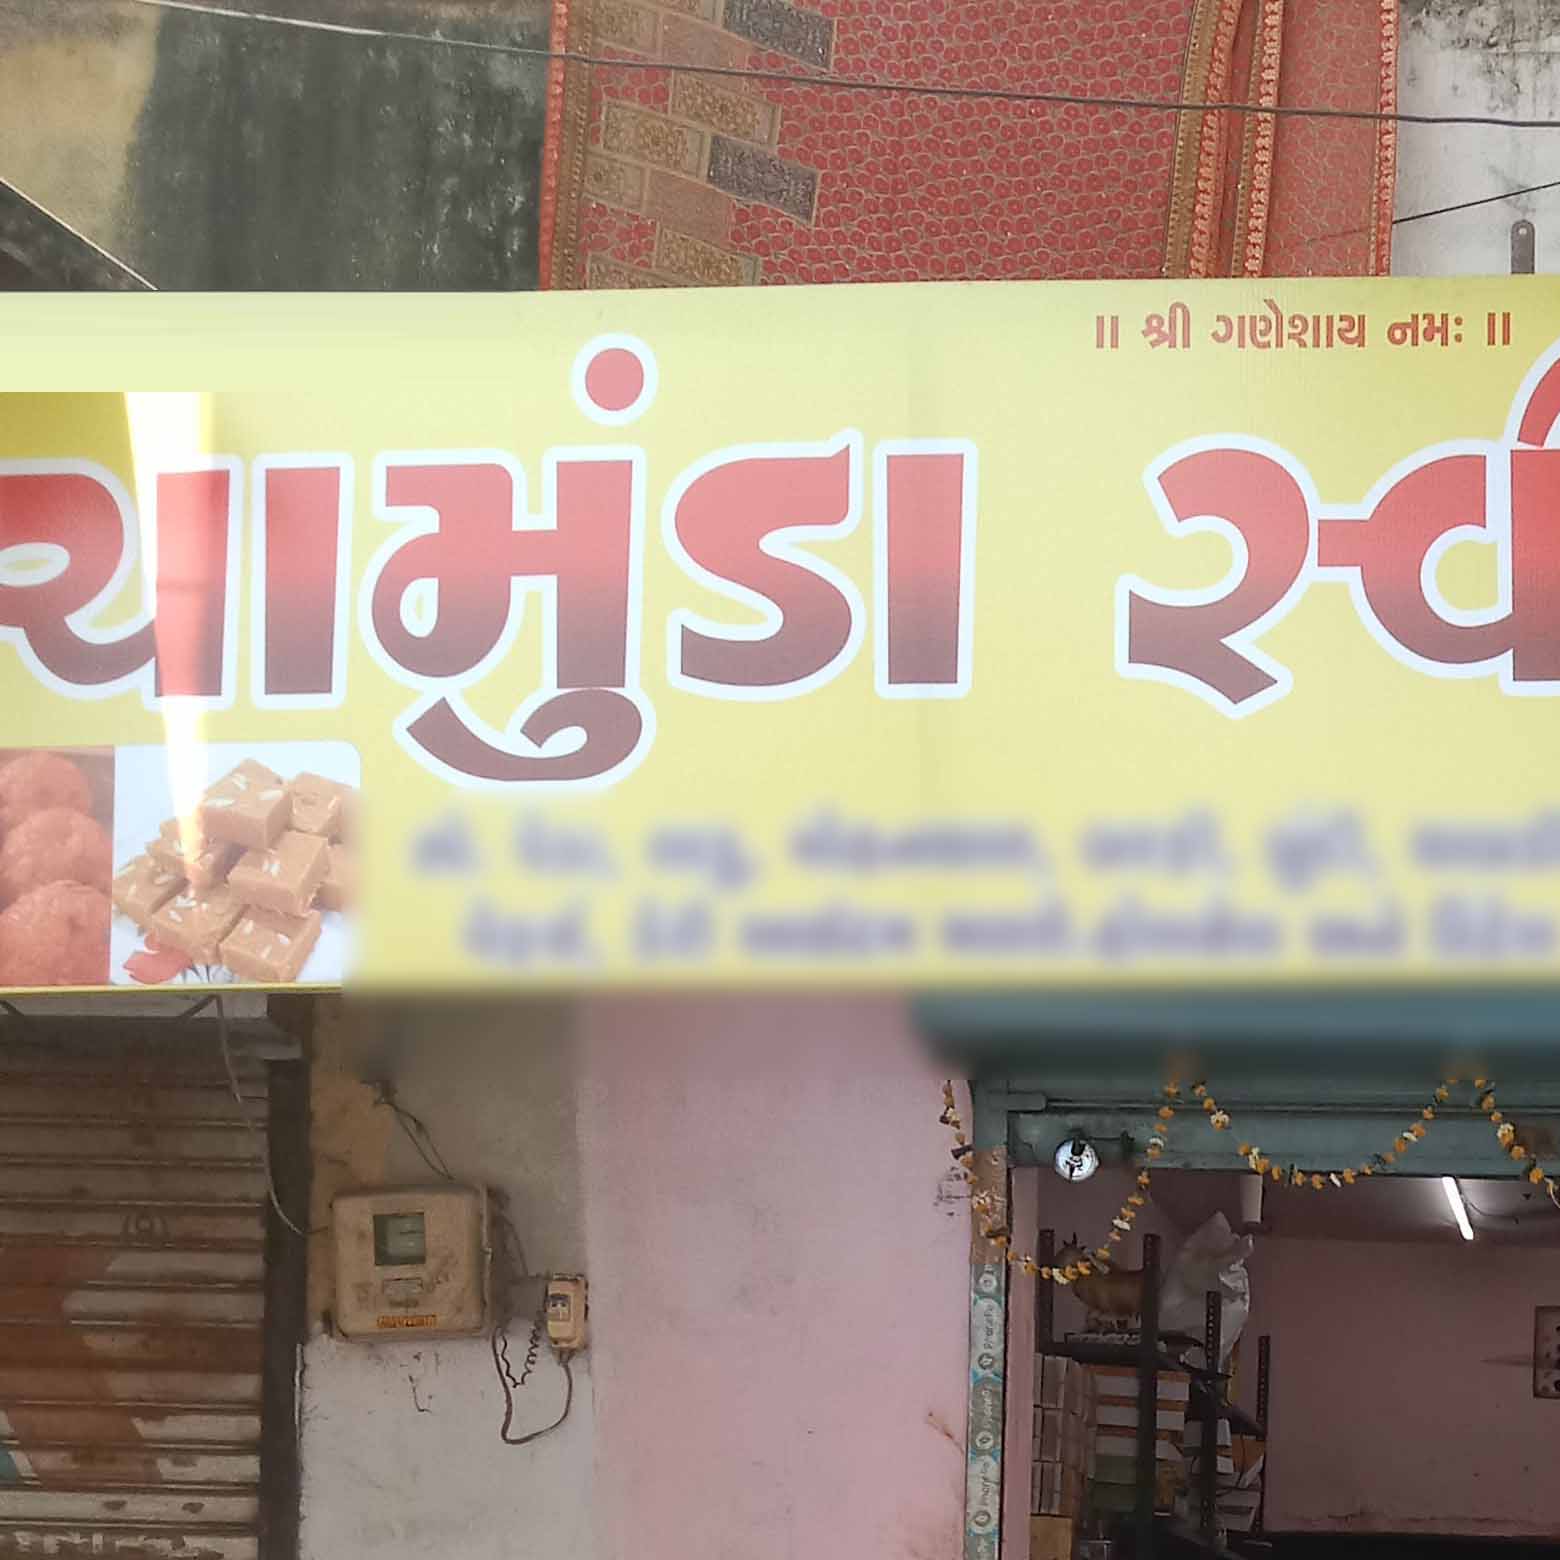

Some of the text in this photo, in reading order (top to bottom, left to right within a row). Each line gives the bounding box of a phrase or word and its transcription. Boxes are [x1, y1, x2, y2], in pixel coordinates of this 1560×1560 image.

[1140, 300, 1193, 350] શ્રી
[1209, 298, 1368, 350] ગણેશાય
[0, 340, 970, 786] ચામુંડા
